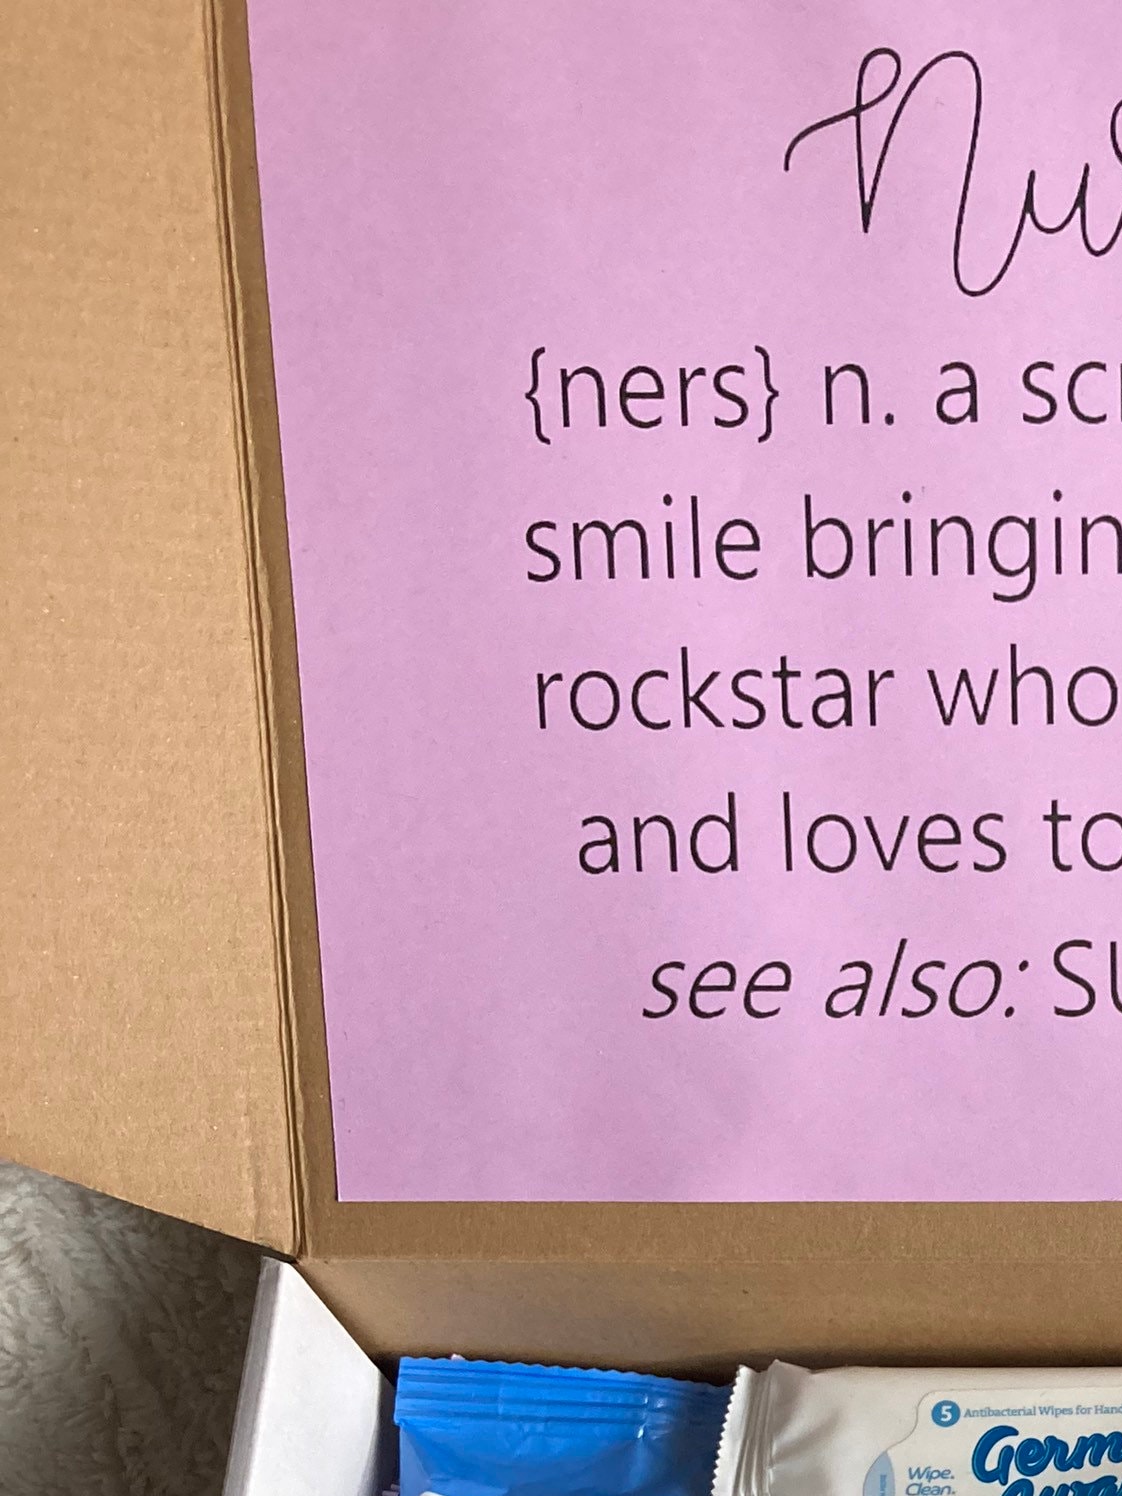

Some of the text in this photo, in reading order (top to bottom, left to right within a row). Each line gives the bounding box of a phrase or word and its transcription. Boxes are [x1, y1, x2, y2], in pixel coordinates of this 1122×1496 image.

[525, 345, 780, 445] {ners}
[824, 362, 895, 426] n.
[935, 362, 979, 425] a
[525, 493, 761, 583] smile
[536, 646, 895, 732] rockstar
[926, 643, 1119, 727] who
[578, 792, 739, 875] and
[782, 792, 1007, 874] loves
[641, 960, 792, 1020] see
[825, 938, 1029, 1018] also:
[940, 1405, 954, 1422] 5
[963, 1406, 1037, 1418] Antibacterial
[1038, 1405, 1073, 1418] Wipes
[1075, 1404, 1093, 1415] for
[905, 1482, 957, 1496] Clean.
[907, 1465, 956, 1482] Wipe.
